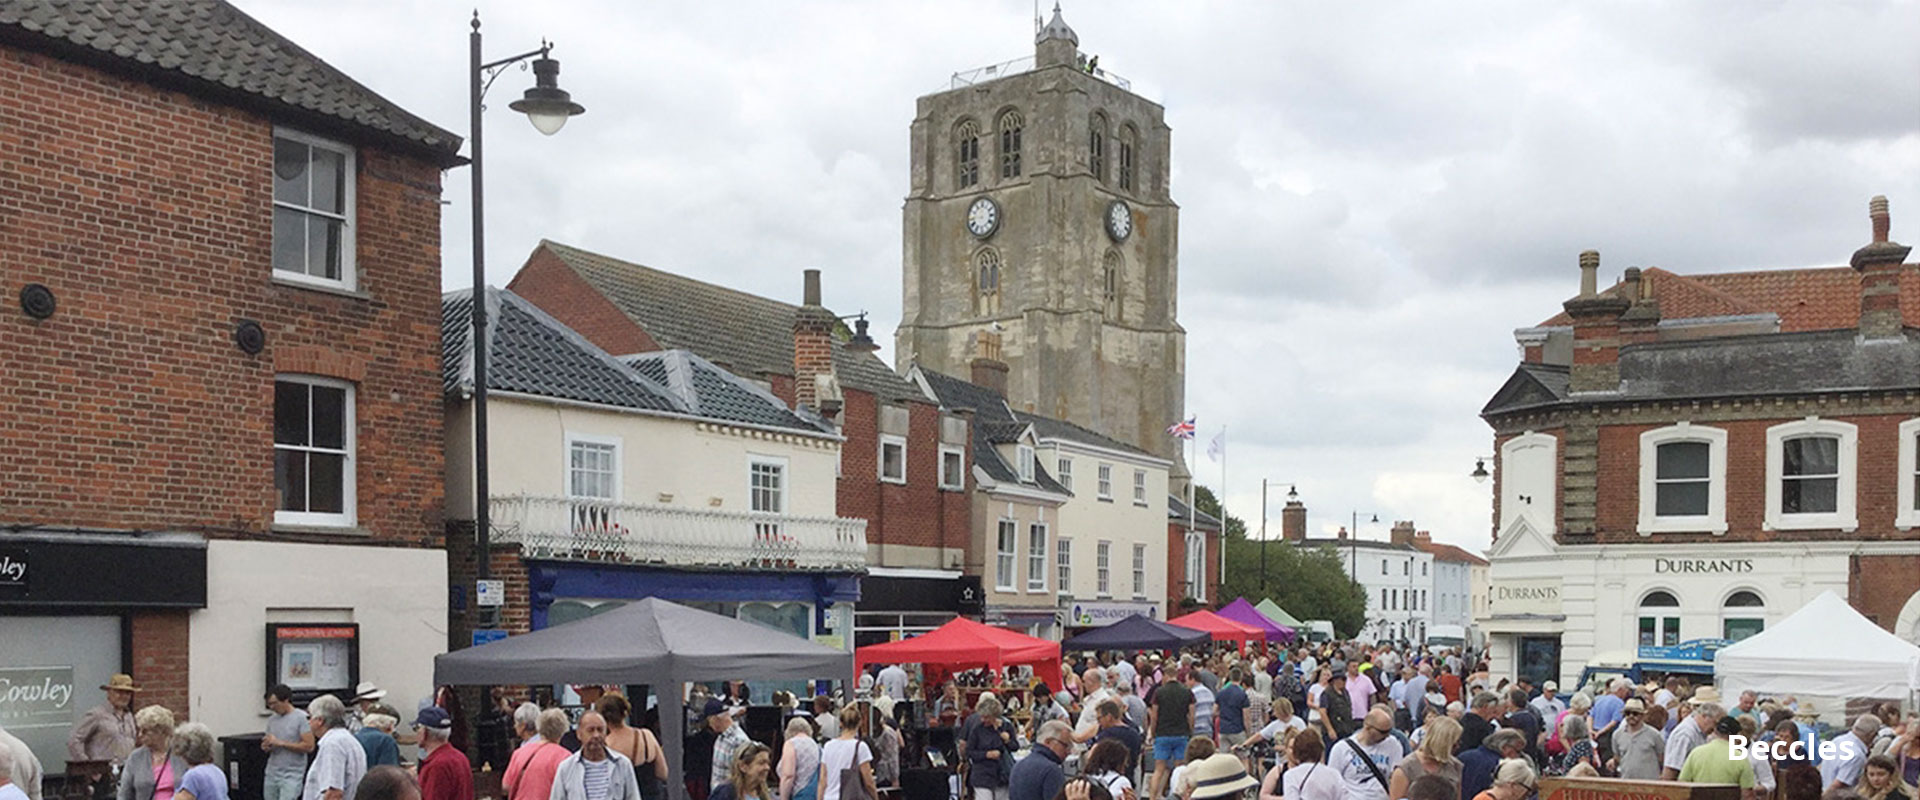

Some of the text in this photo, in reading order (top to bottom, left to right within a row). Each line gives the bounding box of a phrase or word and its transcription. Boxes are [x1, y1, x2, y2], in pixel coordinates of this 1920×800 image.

[0, 556, 26, 581] ley
[1655, 558, 1753, 573] DURRANTS
[1499, 586, 1558, 599] DURRANTS
[0, 677, 72, 708] Cowley
